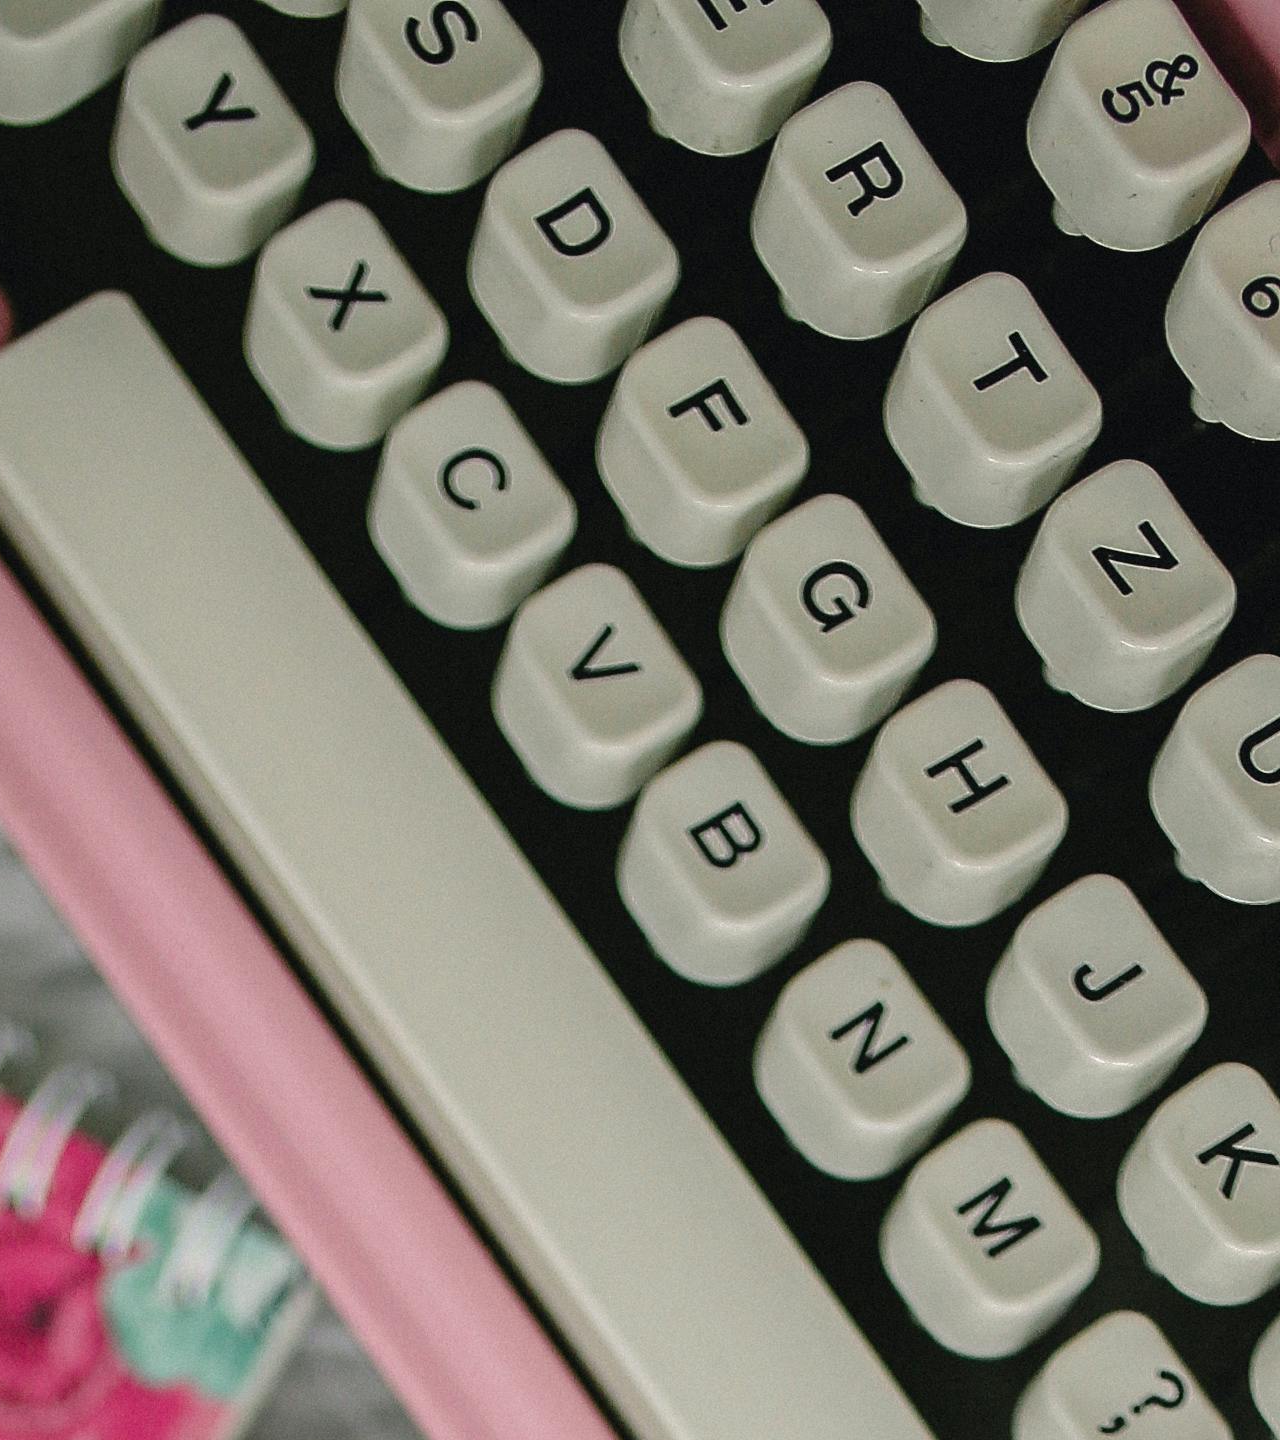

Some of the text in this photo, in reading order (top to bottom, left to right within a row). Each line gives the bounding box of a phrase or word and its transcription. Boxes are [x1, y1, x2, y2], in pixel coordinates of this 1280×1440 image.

[405, 0, 478, 65] S
[184, 73, 257, 131] Y
[1101, 81, 1155, 124] 5
[825, 141, 903, 217] R
[535, 187, 611, 257] D
[308, 262, 388, 331] X
[973, 331, 1048, 391] T
[668, 378, 749, 432] F
[441, 448, 507, 511] C
[1092, 521, 1179, 596] Z
[802, 561, 870, 633] G
[570, 625, 640, 681] V
[926, 739, 1009, 814] H
[689, 801, 762, 869] B
[1073, 964, 1143, 1002] J
[830, 1001, 909, 1075] N
[1197, 1123, 1280, 1200] K
[957, 1177, 1042, 1258] M
